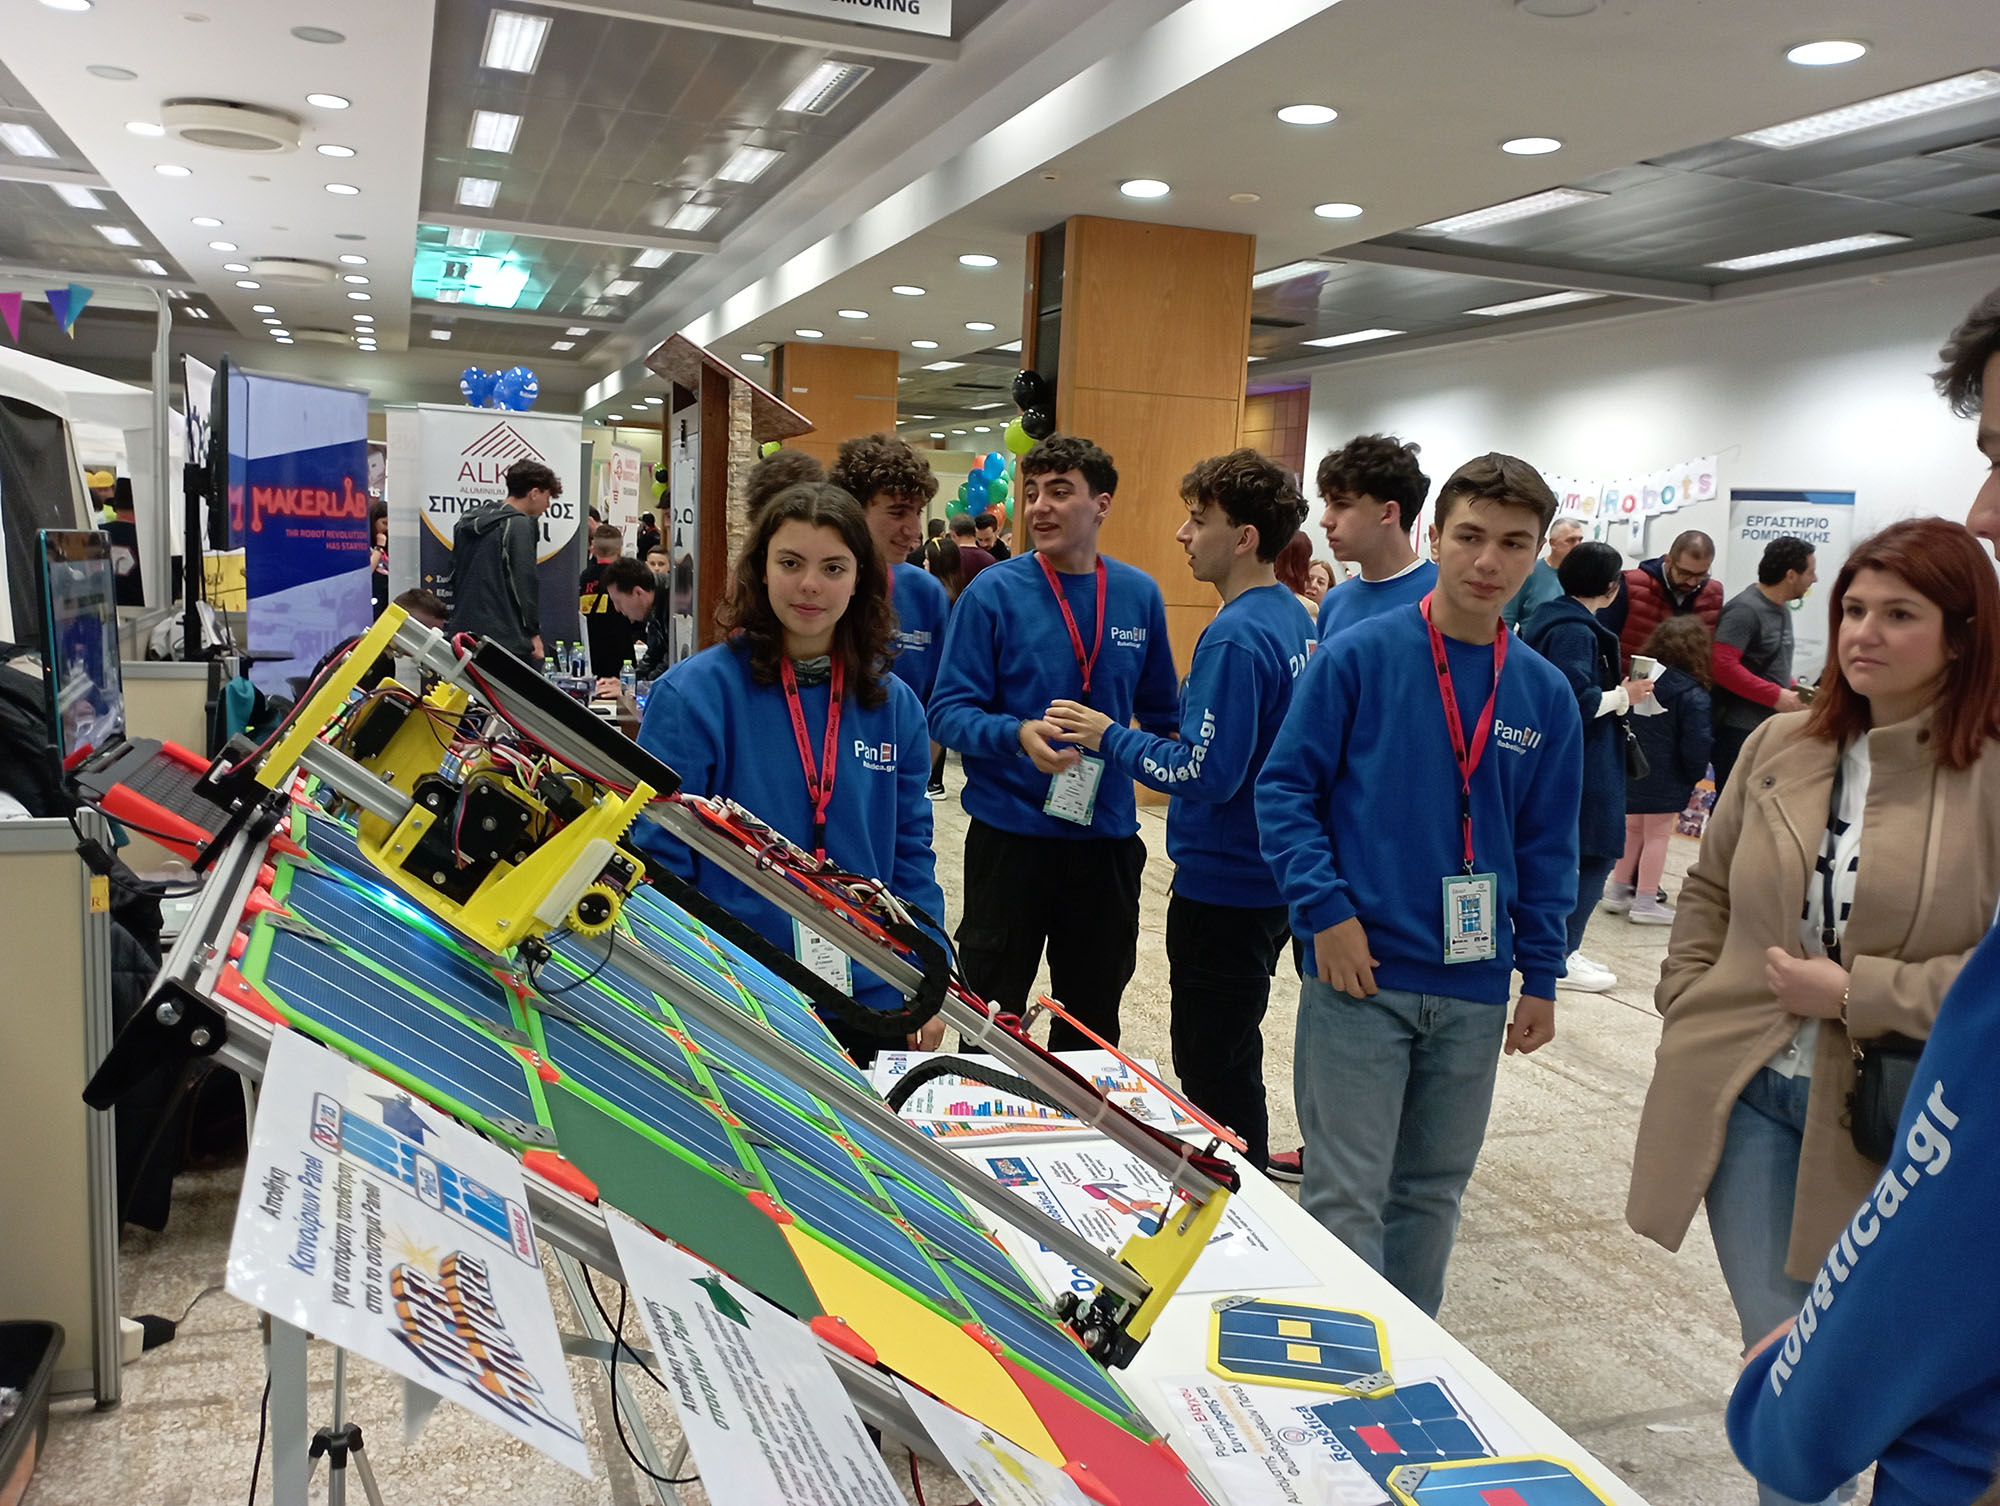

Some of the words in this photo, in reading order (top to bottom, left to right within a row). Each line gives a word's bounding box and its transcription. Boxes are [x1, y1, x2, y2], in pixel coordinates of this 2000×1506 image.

[831, 0, 920, 15] KING
[251, 477, 368, 533] MAKERLAB
[1746, 515, 1829, 529] ΕΡΓΑΣΤΗΡΙΟ
[260, 1168, 290, 1219] Αποθήκη
[298, 1152, 322, 1190] Panel
[333, 1163, 356, 1222] τοποθέτηση
[290, 1190, 322, 1275] Καινούριων
[331, 1223, 355, 1282] αυτόματη
[332, 1282, 354, 1308] για
[362, 1282, 382, 1314] από
[366, 1267, 382, 1283] το
[388, 1259, 522, 1412] SUPER
[663, 1305, 691, 1344] Panel
[669, 1358, 698, 1414] Αποθήκη
[683, 1344, 728, 1429] σπασμένων
[1205, 1400, 1246, 1453] Συντήρησης
[1261, 1456, 1301, 1504] Αυτόματης
